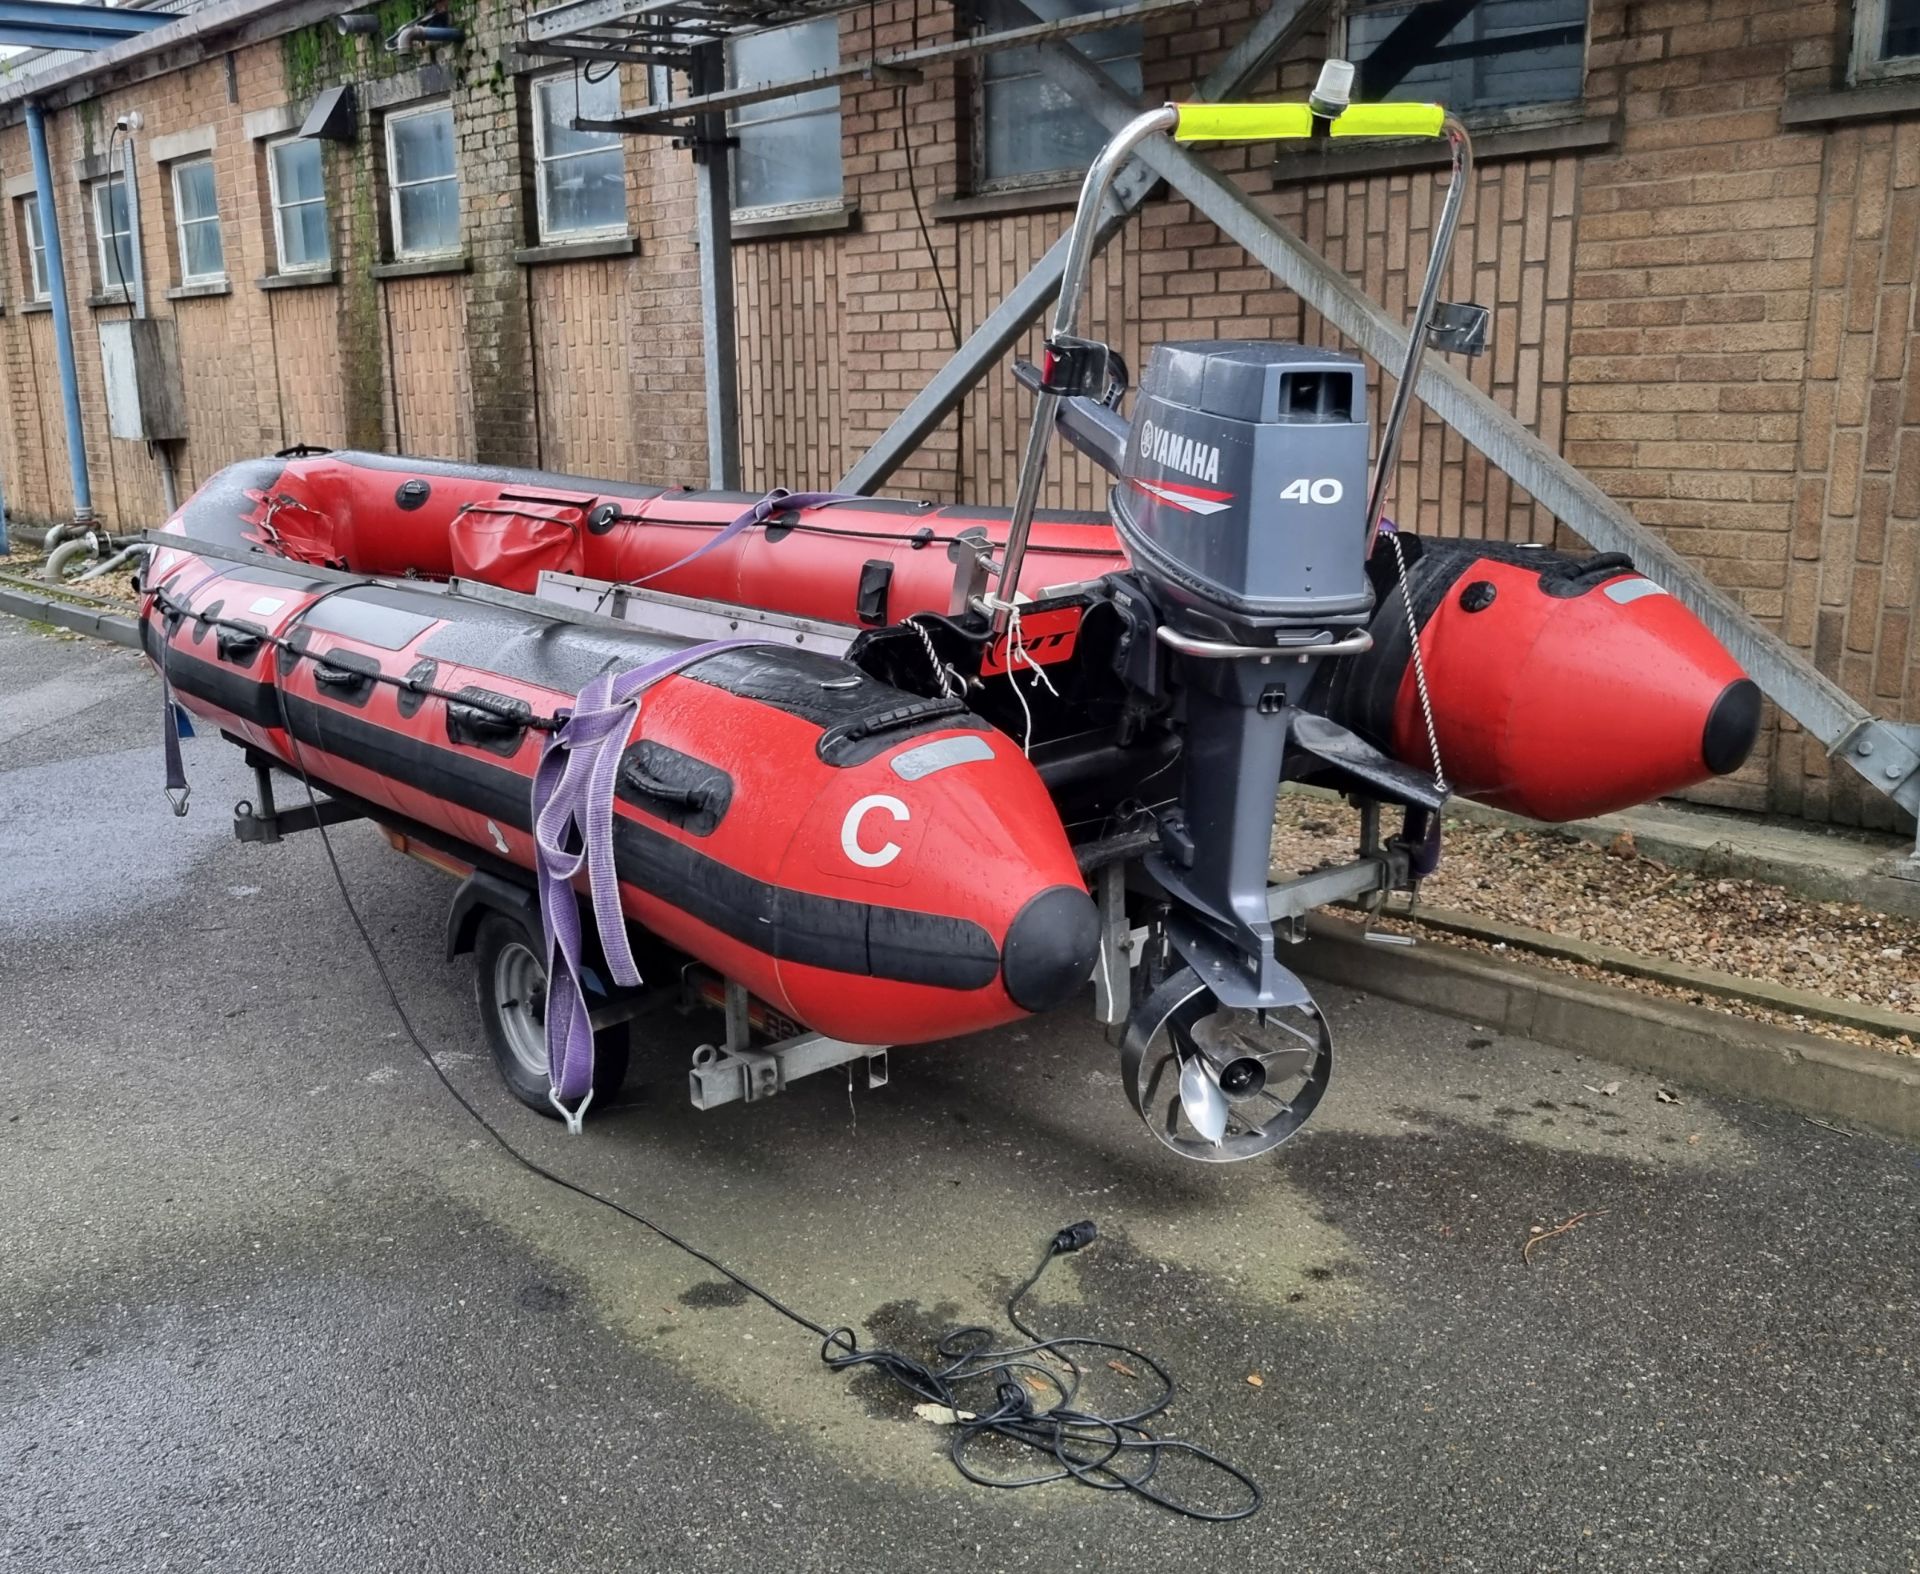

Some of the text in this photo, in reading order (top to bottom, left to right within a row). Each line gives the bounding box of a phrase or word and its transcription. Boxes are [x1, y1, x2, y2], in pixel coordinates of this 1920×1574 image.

[1153, 427, 1219, 484] YAMAHA
[1280, 478, 1343, 504] 40
[841, 794, 910, 868] C
